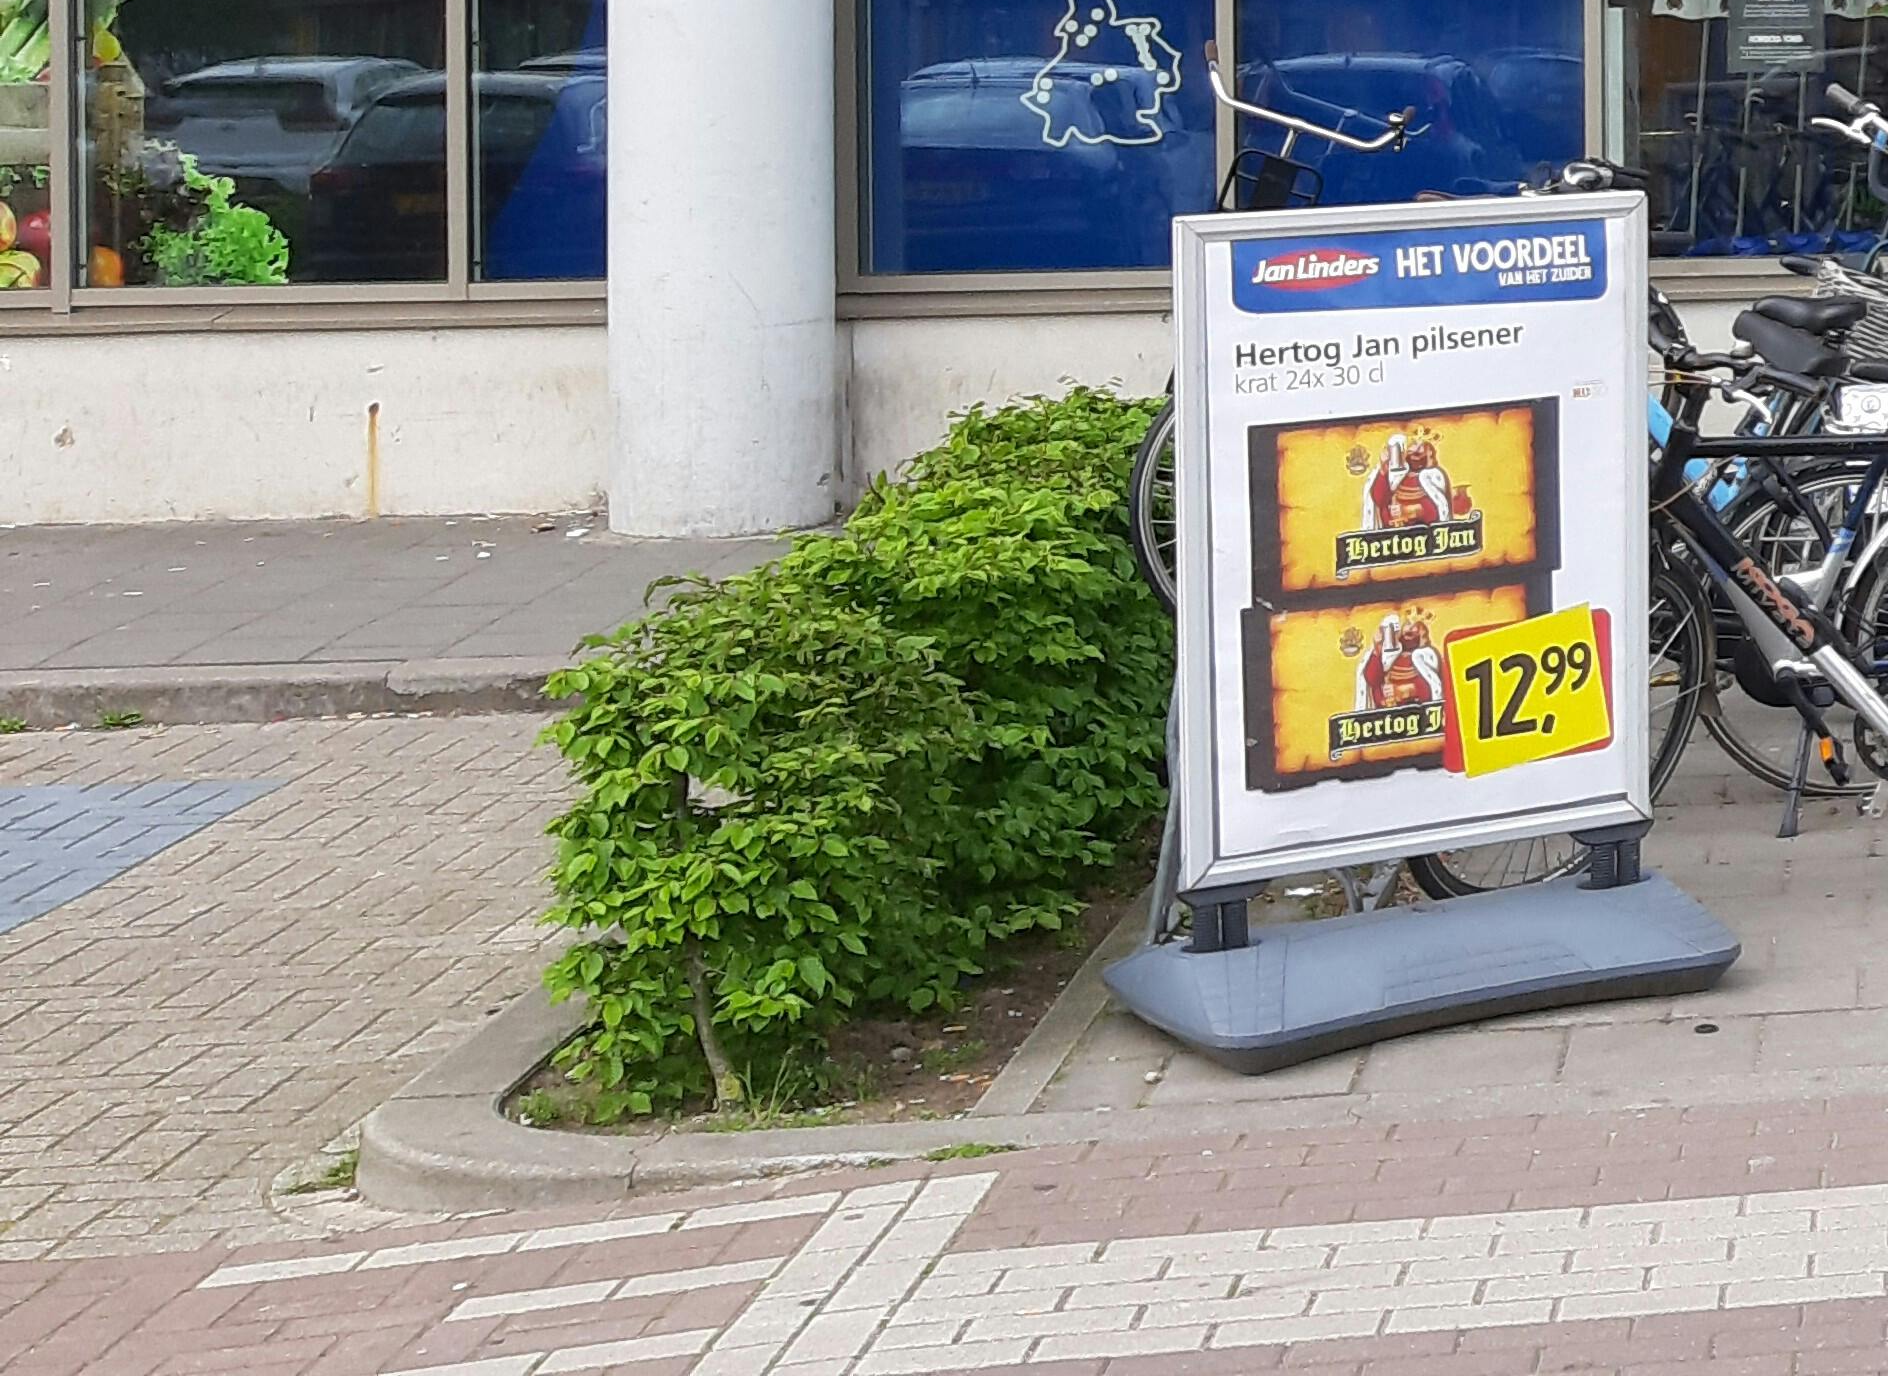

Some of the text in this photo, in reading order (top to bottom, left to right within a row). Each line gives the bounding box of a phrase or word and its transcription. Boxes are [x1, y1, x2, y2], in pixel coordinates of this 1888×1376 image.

[1252, 235, 1590, 285] Jan Linders HET VOORDEEL
[1498, 269, 1523, 287] VAN
[1235, 324, 1524, 369] Hertog Jan pilsener
[1235, 362, 1384, 394] krat 24x 30 cl
[1345, 524, 1476, 563] Hertog Jan
[1338, 709, 1420, 743] Hertog
